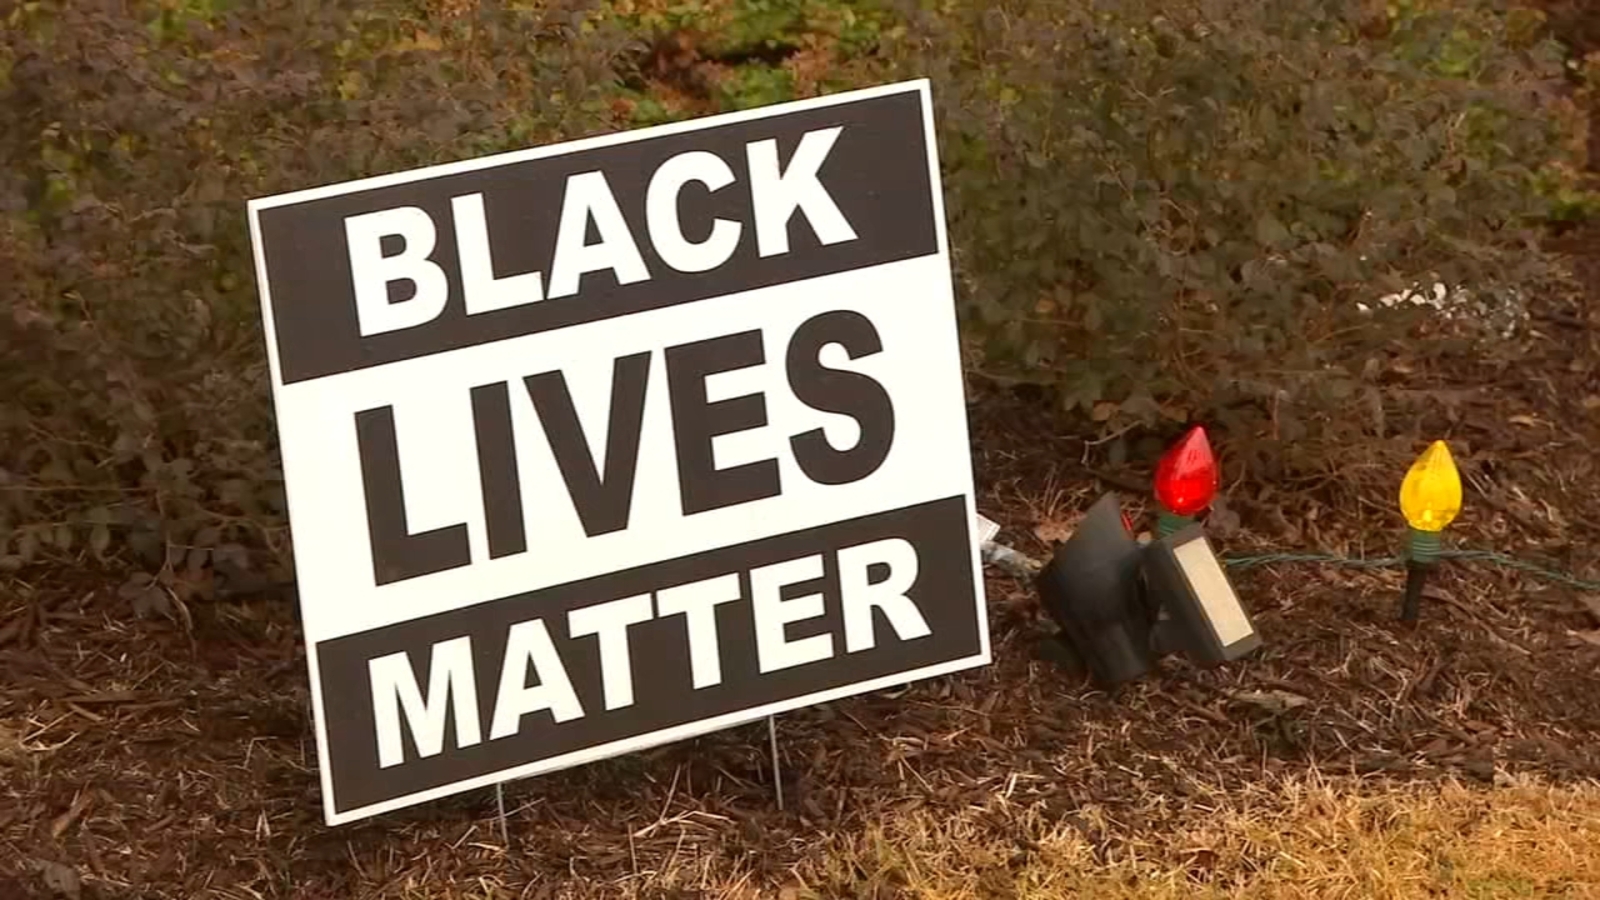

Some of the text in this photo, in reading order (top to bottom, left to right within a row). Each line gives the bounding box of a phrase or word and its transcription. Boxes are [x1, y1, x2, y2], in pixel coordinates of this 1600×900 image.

[344, 126, 858, 337] BLACK
[354, 309, 896, 587] LIVES
[368, 538, 932, 769] MATTER
